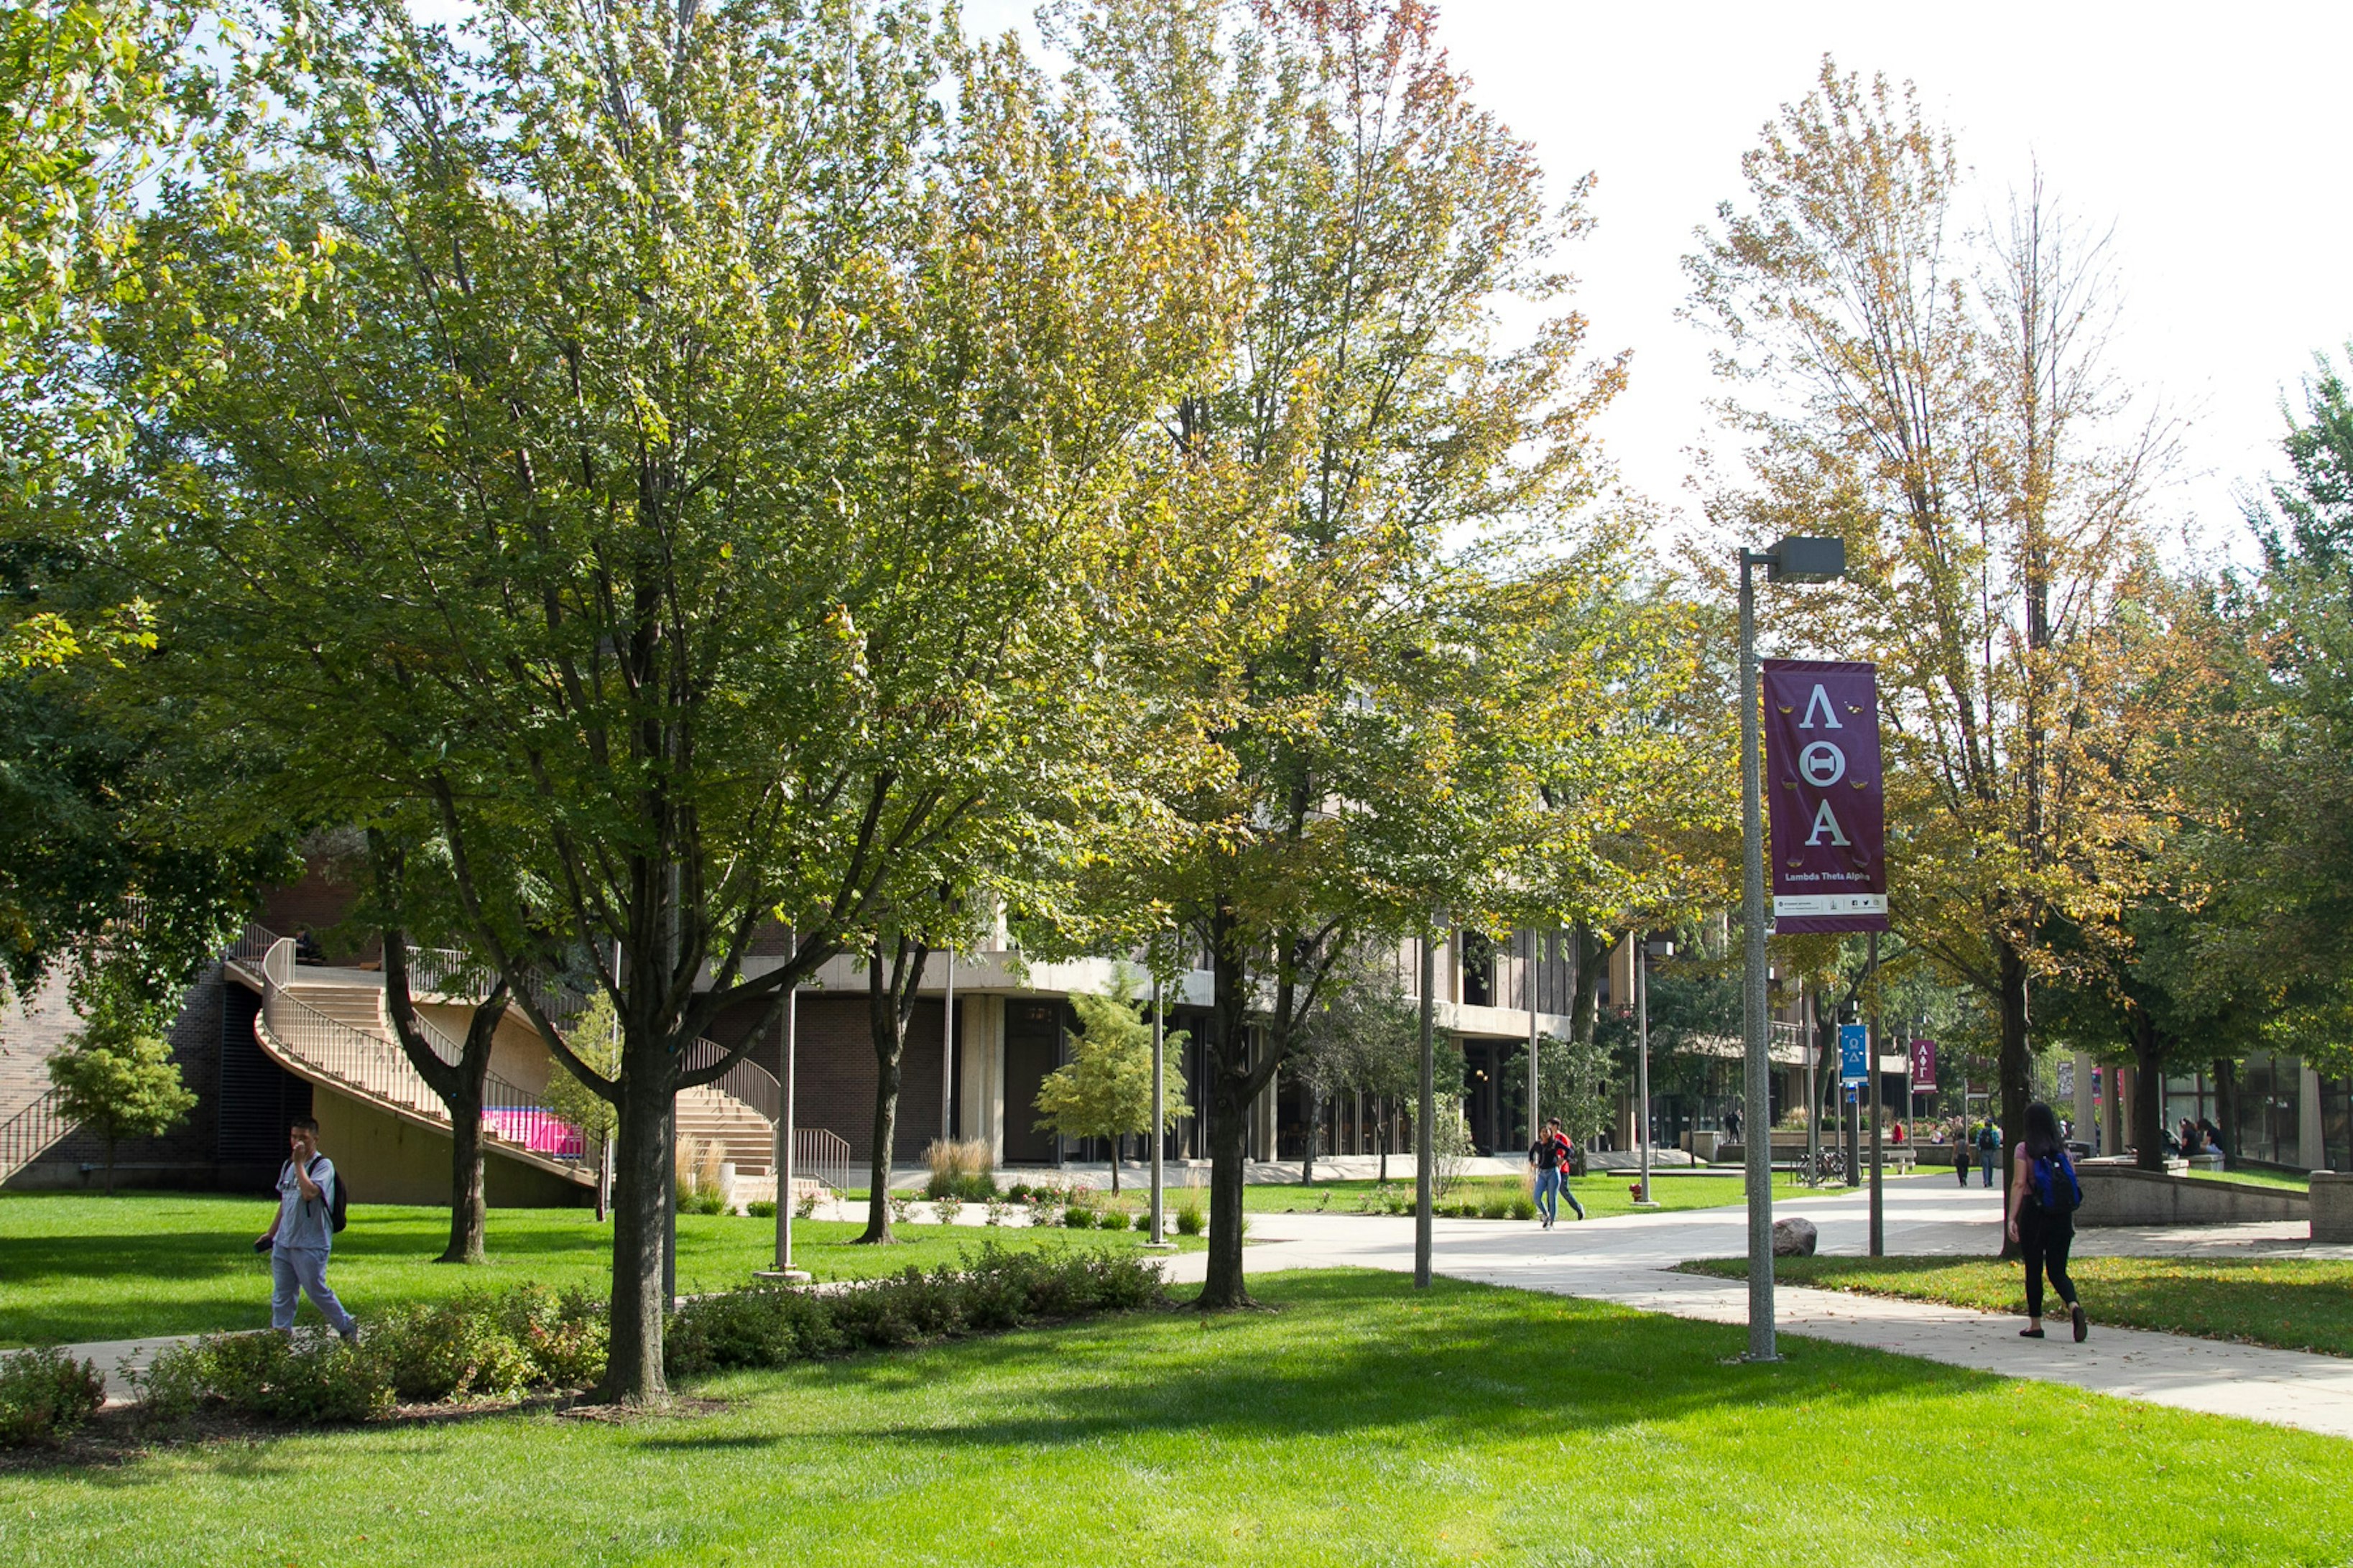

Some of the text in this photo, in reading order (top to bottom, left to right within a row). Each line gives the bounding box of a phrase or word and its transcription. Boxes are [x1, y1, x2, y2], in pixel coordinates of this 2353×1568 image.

[1785, 871, 1871, 881] Lambda Theta Alpha
